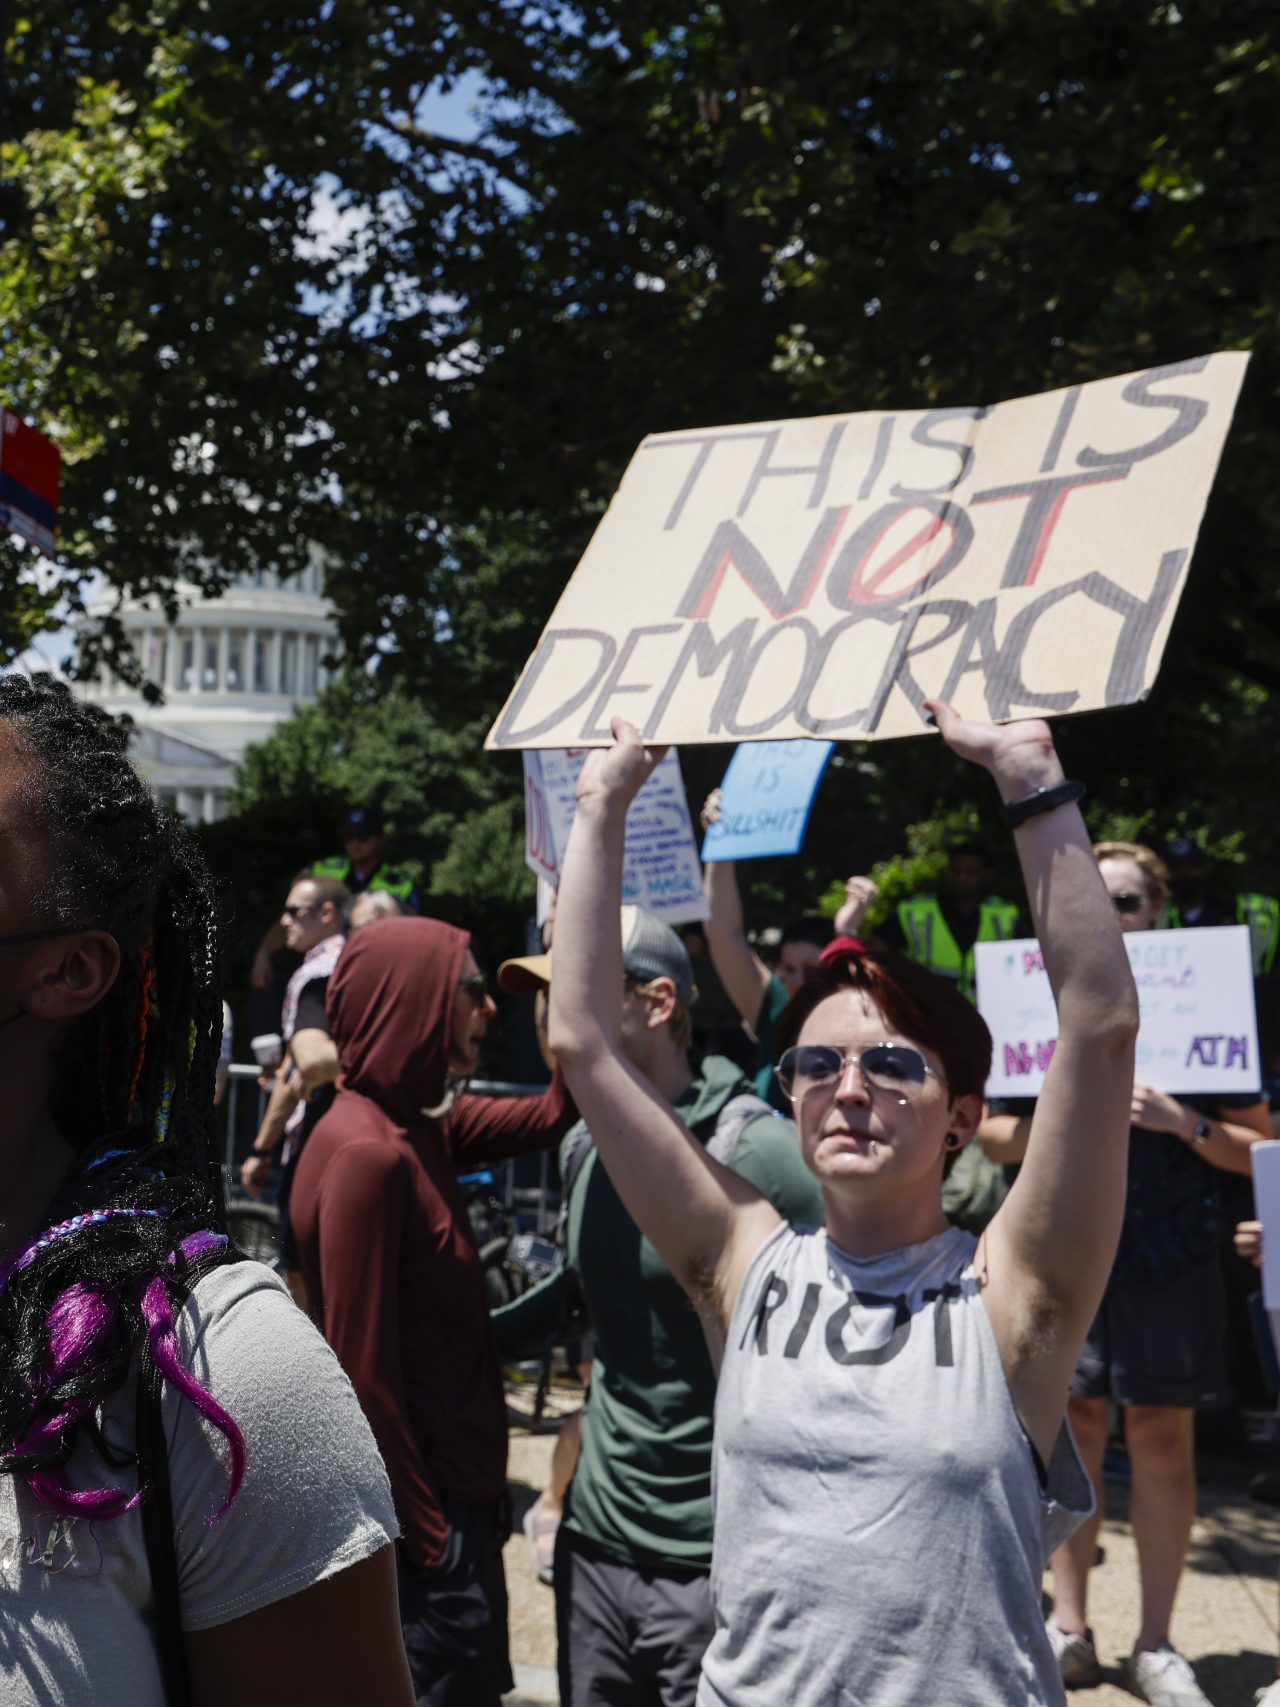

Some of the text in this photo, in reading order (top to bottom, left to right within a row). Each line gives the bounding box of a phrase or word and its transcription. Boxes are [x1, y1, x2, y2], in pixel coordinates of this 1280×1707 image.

[643, 356, 1210, 530] THIS IS
[675, 465, 1132, 621] NOT
[493, 548, 1189, 746] DEMOCRACY
[1185, 1033, 1250, 1070] ATM
[738, 1271, 962, 1367] RIOT
